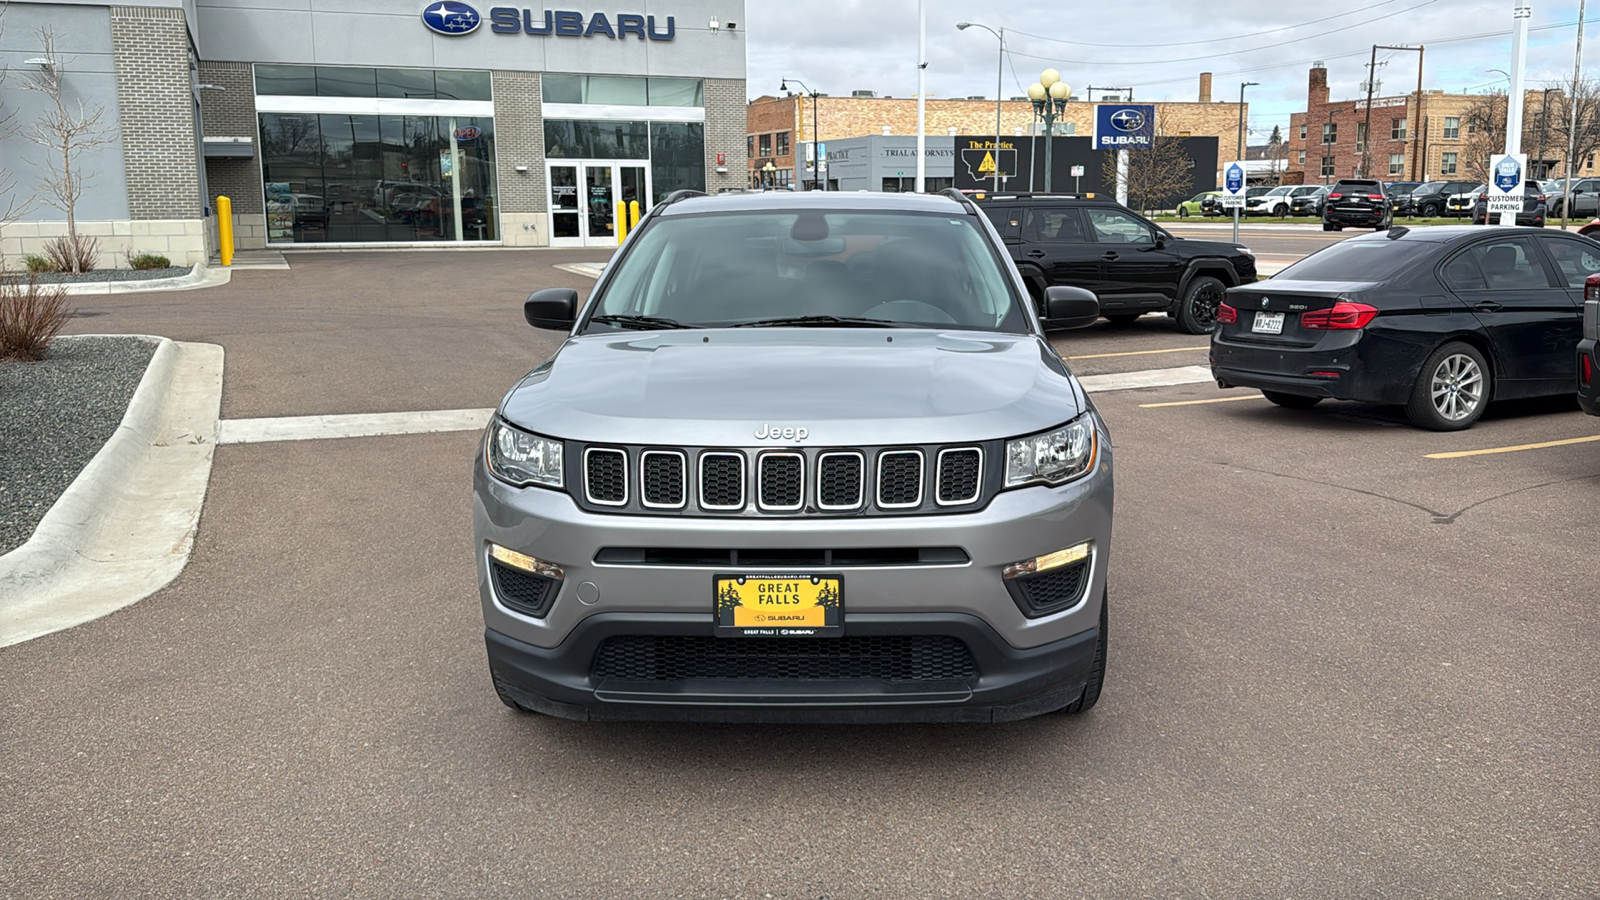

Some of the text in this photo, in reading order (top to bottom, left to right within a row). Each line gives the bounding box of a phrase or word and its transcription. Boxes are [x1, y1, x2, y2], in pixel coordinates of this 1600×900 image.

[490, 6, 676, 41] SUBARU
[454, 128, 479, 139] OPEN
[969, 141, 1013, 149] The Pratice
[1101, 135, 1150, 145] SUBARU
[826, 150, 849, 160] PRACTICE
[885, 149, 954, 157] TRIAL ATORNEYS
[754, 423, 809, 442] Jeep
[758, 583, 800, 593] GREAT
[758, 594, 800, 605] FALLS
